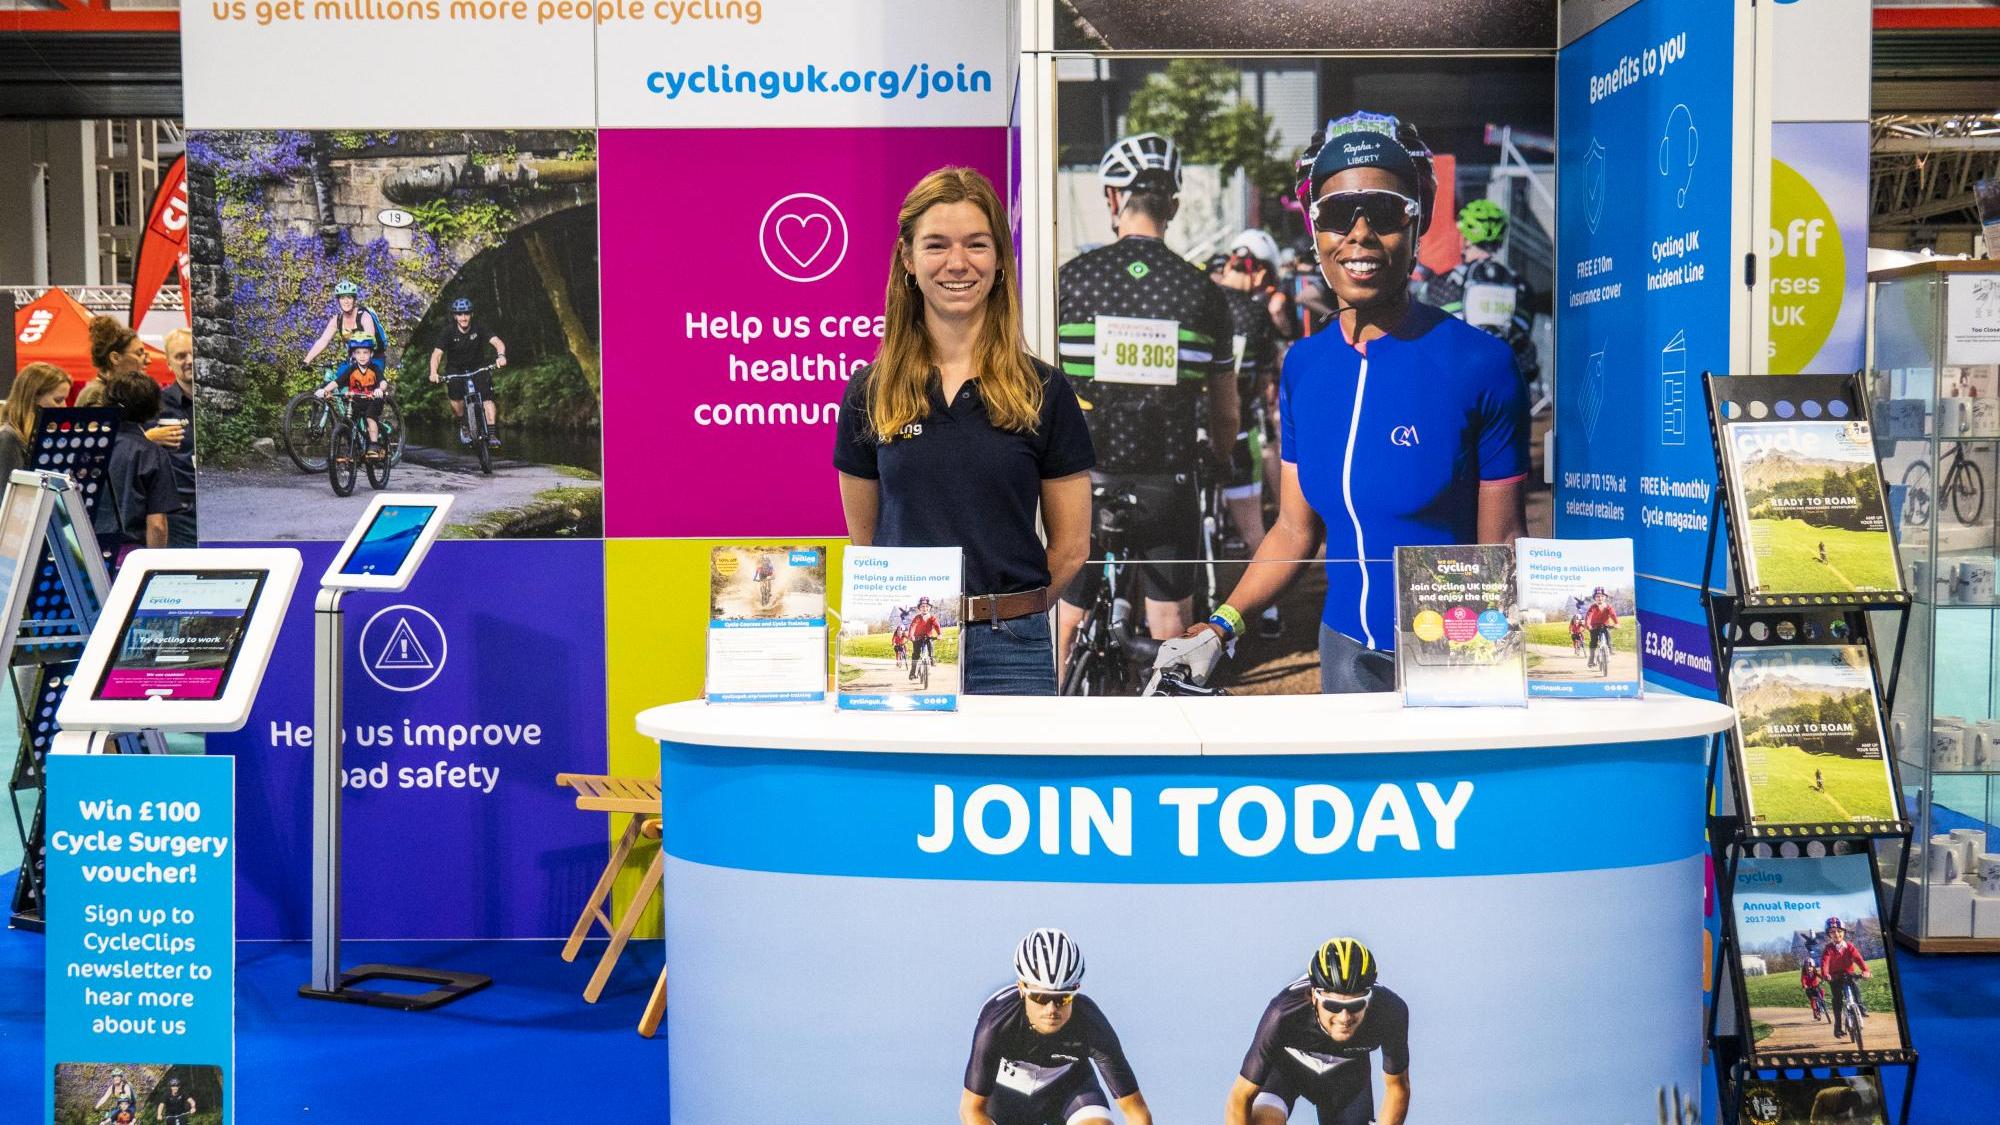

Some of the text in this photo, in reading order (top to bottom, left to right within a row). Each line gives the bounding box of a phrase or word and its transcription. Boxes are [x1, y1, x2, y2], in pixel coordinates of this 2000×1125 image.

[212, 0, 762, 25] us get millions more people cycling
[1590, 31, 1686, 104] Benefits to you
[646, 64, 992, 100] cyclinguk.org/join
[1347, 154, 1380, 165] LIBERTY
[390, 213, 401, 224] 19
[1652, 230, 1700, 264] Cycling UK
[1577, 255, 1613, 279] FREE £10m
[1647, 261, 1705, 291] Incident Line
[1569, 283, 1622, 308] insurance cover
[1772, 306, 1805, 326] UK
[685, 311, 763, 344] Help
[773, 315, 810, 338] us
[1565, 472, 1627, 493] SAVE UP TO 15% at
[1640, 477, 1710, 504] FREE bi-monthly
[1566, 499, 1625, 521] selected retailers
[1771, 496, 1857, 507] READY TO ROAM
[1641, 505, 1708, 532] Cycle magazine
[854, 558, 888, 568] cycling
[1529, 549, 1562, 558] cycling
[853, 573, 888, 582] Helping
[1437, 563, 1480, 574] cycling
[1529, 563, 1562, 573] Helping
[853, 583, 908, 591] people cycle
[1410, 583, 1430, 591] Join
[1431, 583, 1466, 592] Cycling
[1481, 583, 1508, 592] today
[1438, 593, 1464, 602] enjoy
[1481, 592, 1500, 600] ride
[1646, 631, 1712, 673] £3.88 per month
[357, 725, 394, 746] us
[404, 719, 542, 751] improve
[1768, 723, 1853, 733] READY TO ROAM
[399, 761, 500, 793] safety
[79, 799, 201, 823] Win £100
[917, 781, 1475, 858] JOIN TODAY
[51, 830, 229, 857] Cycle Surgery
[81, 862, 197, 884] voucher!
[1738, 871, 1783, 884] cycling
[84, 904, 195, 927] Sign up to
[1743, 901, 1821, 912] Annual Report
[1745, 915, 1786, 923] 2017-2018
[83, 932, 196, 955] CycleClips
[67, 960, 212, 980] newsletter to
[85, 987, 194, 1007] hear more
[92, 1015, 187, 1035] about us
